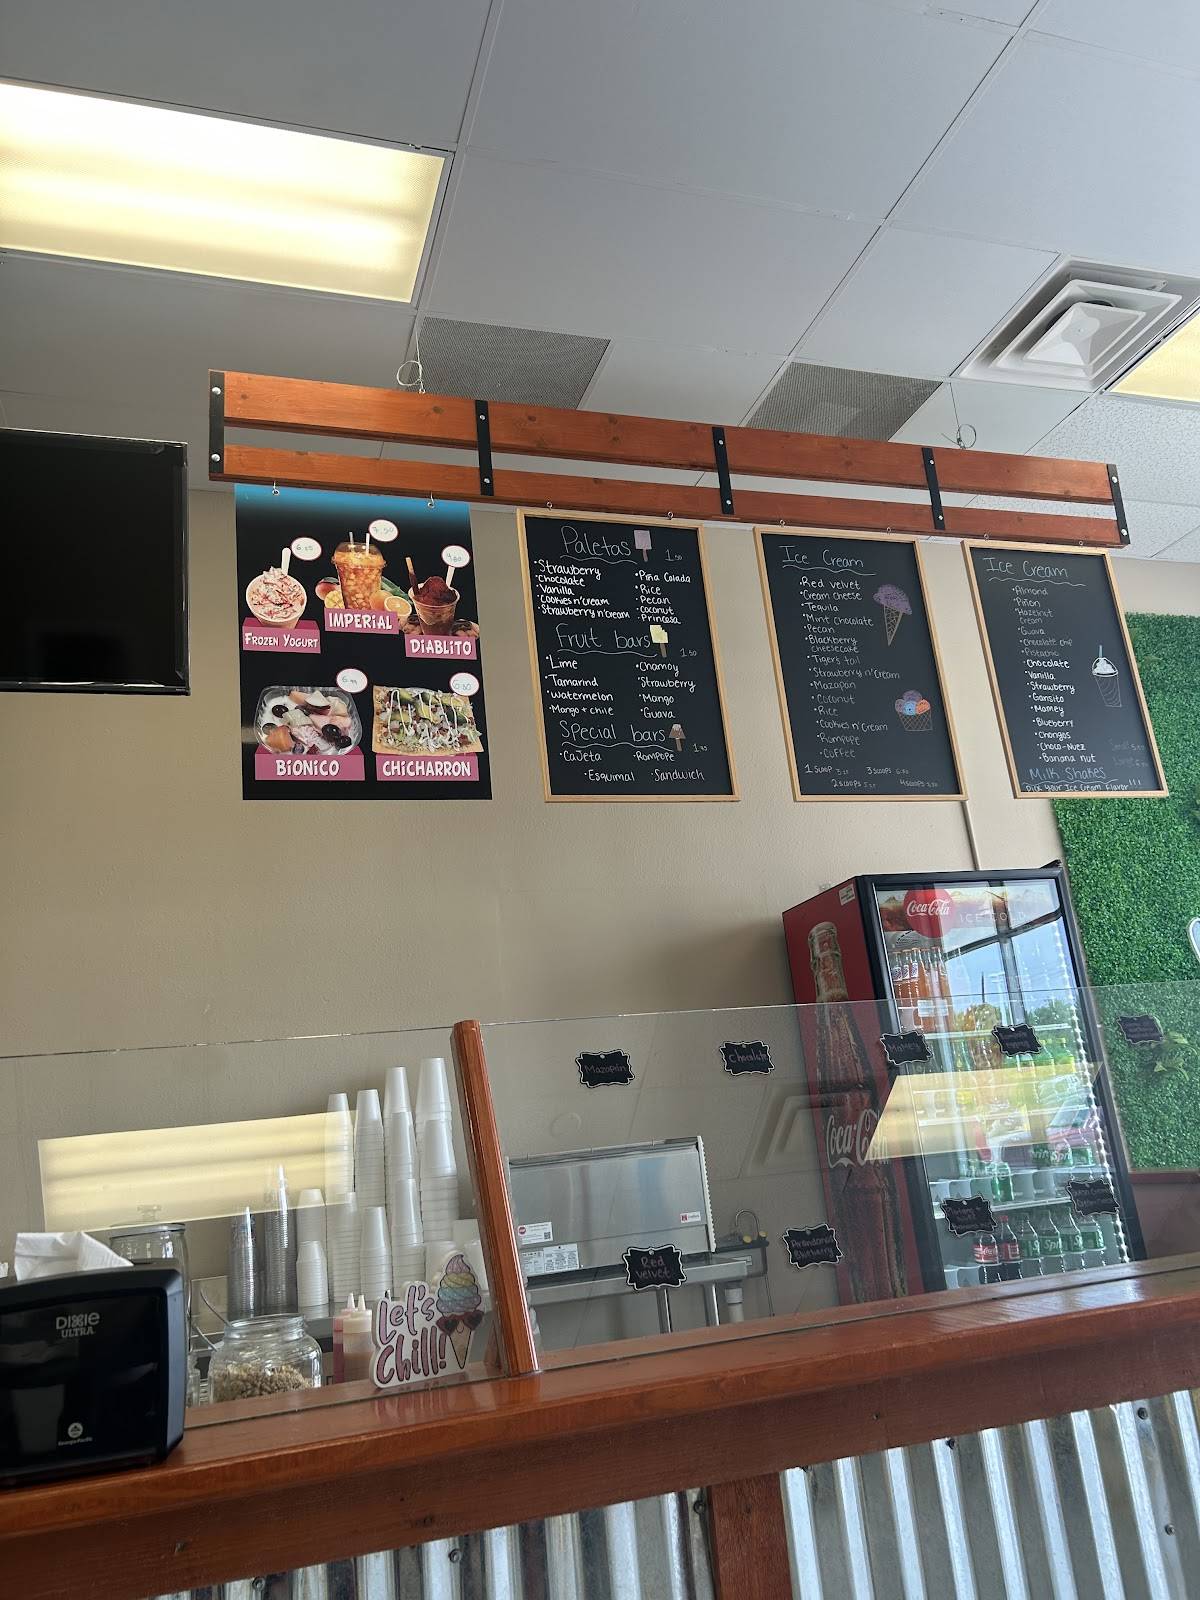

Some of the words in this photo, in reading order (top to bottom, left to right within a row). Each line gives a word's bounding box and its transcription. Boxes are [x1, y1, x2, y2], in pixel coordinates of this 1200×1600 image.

[560, 525, 632, 557] Paletas
[779, 545, 810, 565] Ice
[822, 549, 864, 568] Cream
[538, 559, 602, 581] Strawberry
[983, 557, 1015, 575] Ice
[1022, 560, 1068, 578] Cream
[801, 576, 825, 589] Red
[540, 585, 575, 596] Vanilla
[640, 584, 662, 595] Rice
[802, 589, 830, 601] Cream
[640, 596, 671, 605] Pecan
[804, 601, 840, 613] Tequila
[541, 604, 596, 619] Strawberry
[641, 614, 682, 625] Princesa
[805, 613, 831, 625] Mint
[555, 622, 602, 649] Fruit
[614, 630, 651, 649] bars
[806, 624, 836, 634] Pecan
[808, 634, 858, 646] Blackberry
[549, 654, 578, 670] Lime
[639, 662, 680, 677] Chamoy
[812, 666, 863, 679] Strawberry
[1027, 670, 1056, 681] Vanilla
[548, 673, 599, 687] Tamarind
[640, 676, 696, 693] Strawberry
[1030, 682, 1076, 695] Strawberry
[642, 694, 675, 706] Mango
[1032, 692, 1065, 703] Gansito
[551, 704, 580, 717] Mango
[643, 706, 676, 720] Guava
[818, 705, 839, 717] Rice
[1034, 704, 1065, 717] Mamey
[630, 724, 666, 743] bars
[1042, 752, 1077, 763] Banana
[588, 769, 635, 783] Esquimal
[654, 768, 705, 782] Sandwich
[1029, 767, 1061, 781] Milk
[906, 899, 950, 917] Coca-Cola
[640, 1255, 665, 1269] Red
[379, 1285, 436, 1345] Let's
[61, 1326, 95, 1338] ULTRA
[376, 1325, 447, 1385] Chill!
